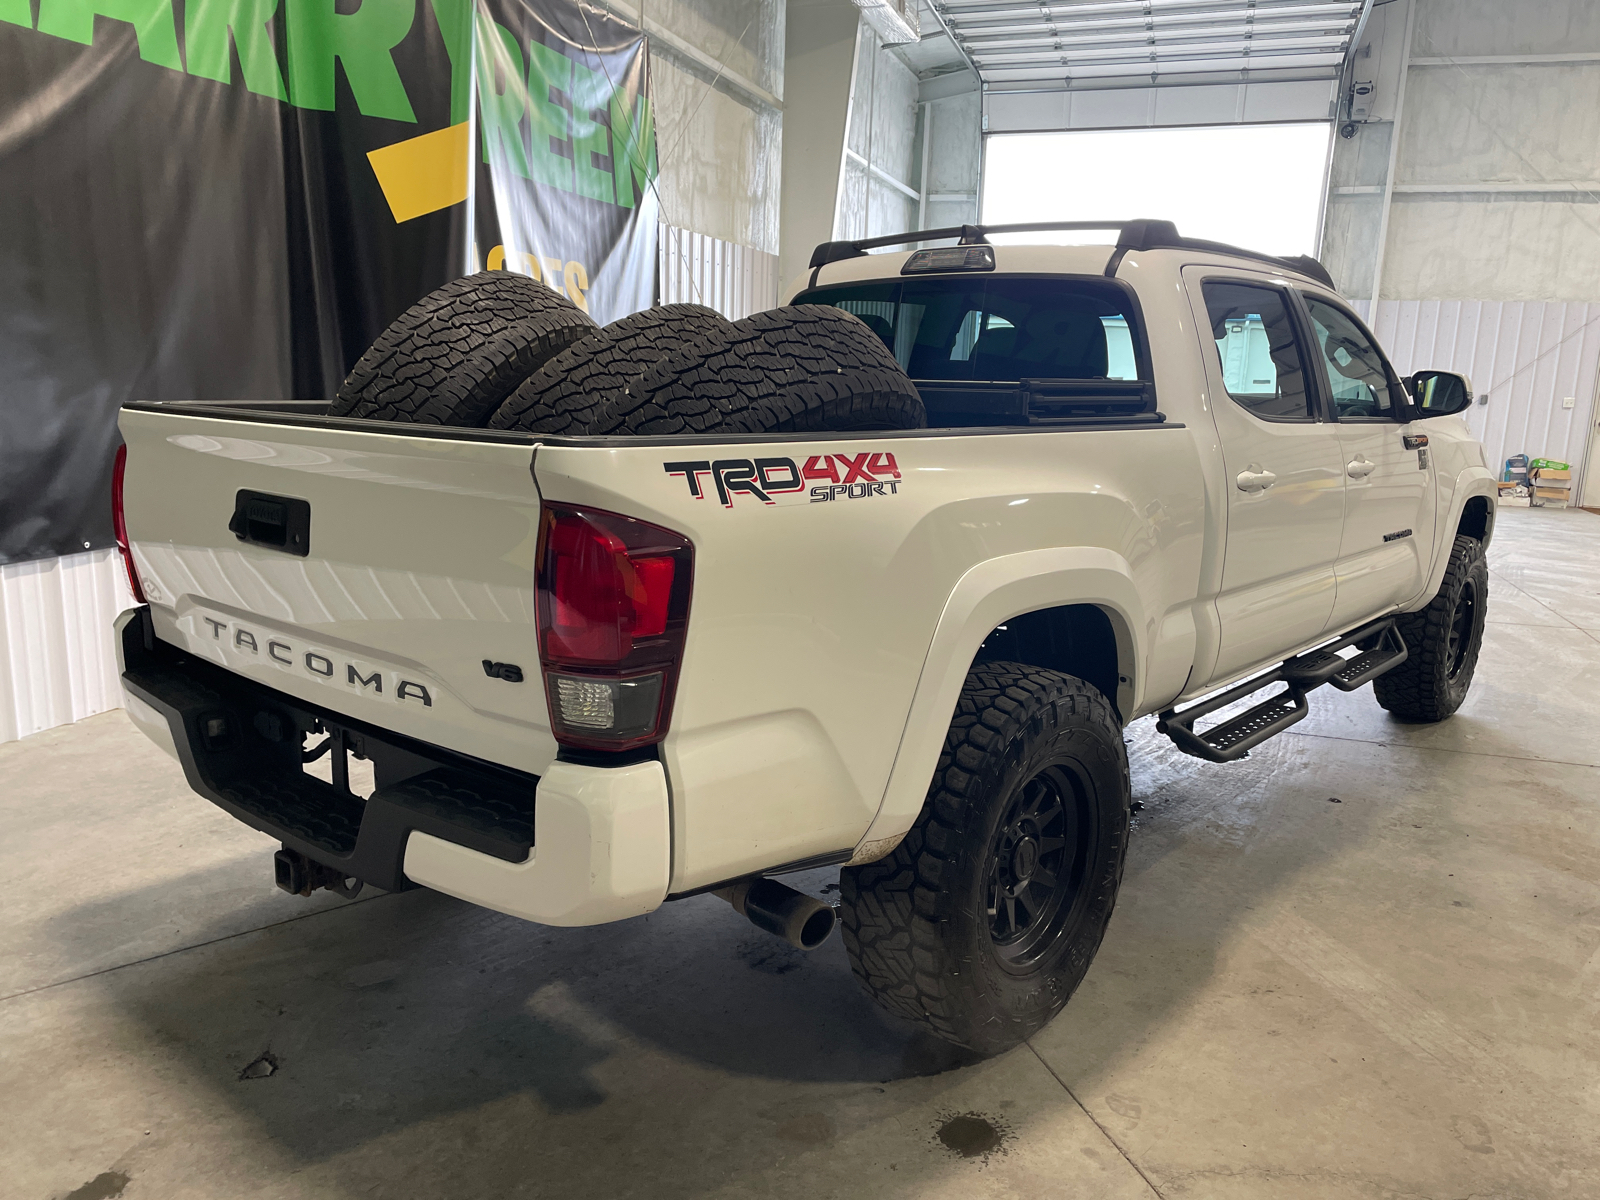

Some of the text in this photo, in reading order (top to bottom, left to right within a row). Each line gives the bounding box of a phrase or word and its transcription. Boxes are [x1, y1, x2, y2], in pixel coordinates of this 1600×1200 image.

[0, 0, 470, 126] ARRY
[663, 452, 902, 508] TRD 4X4
[810, 479, 902, 503] SPORT
[203, 616, 432, 708] TACOMA
[482, 659, 524, 683] V6
